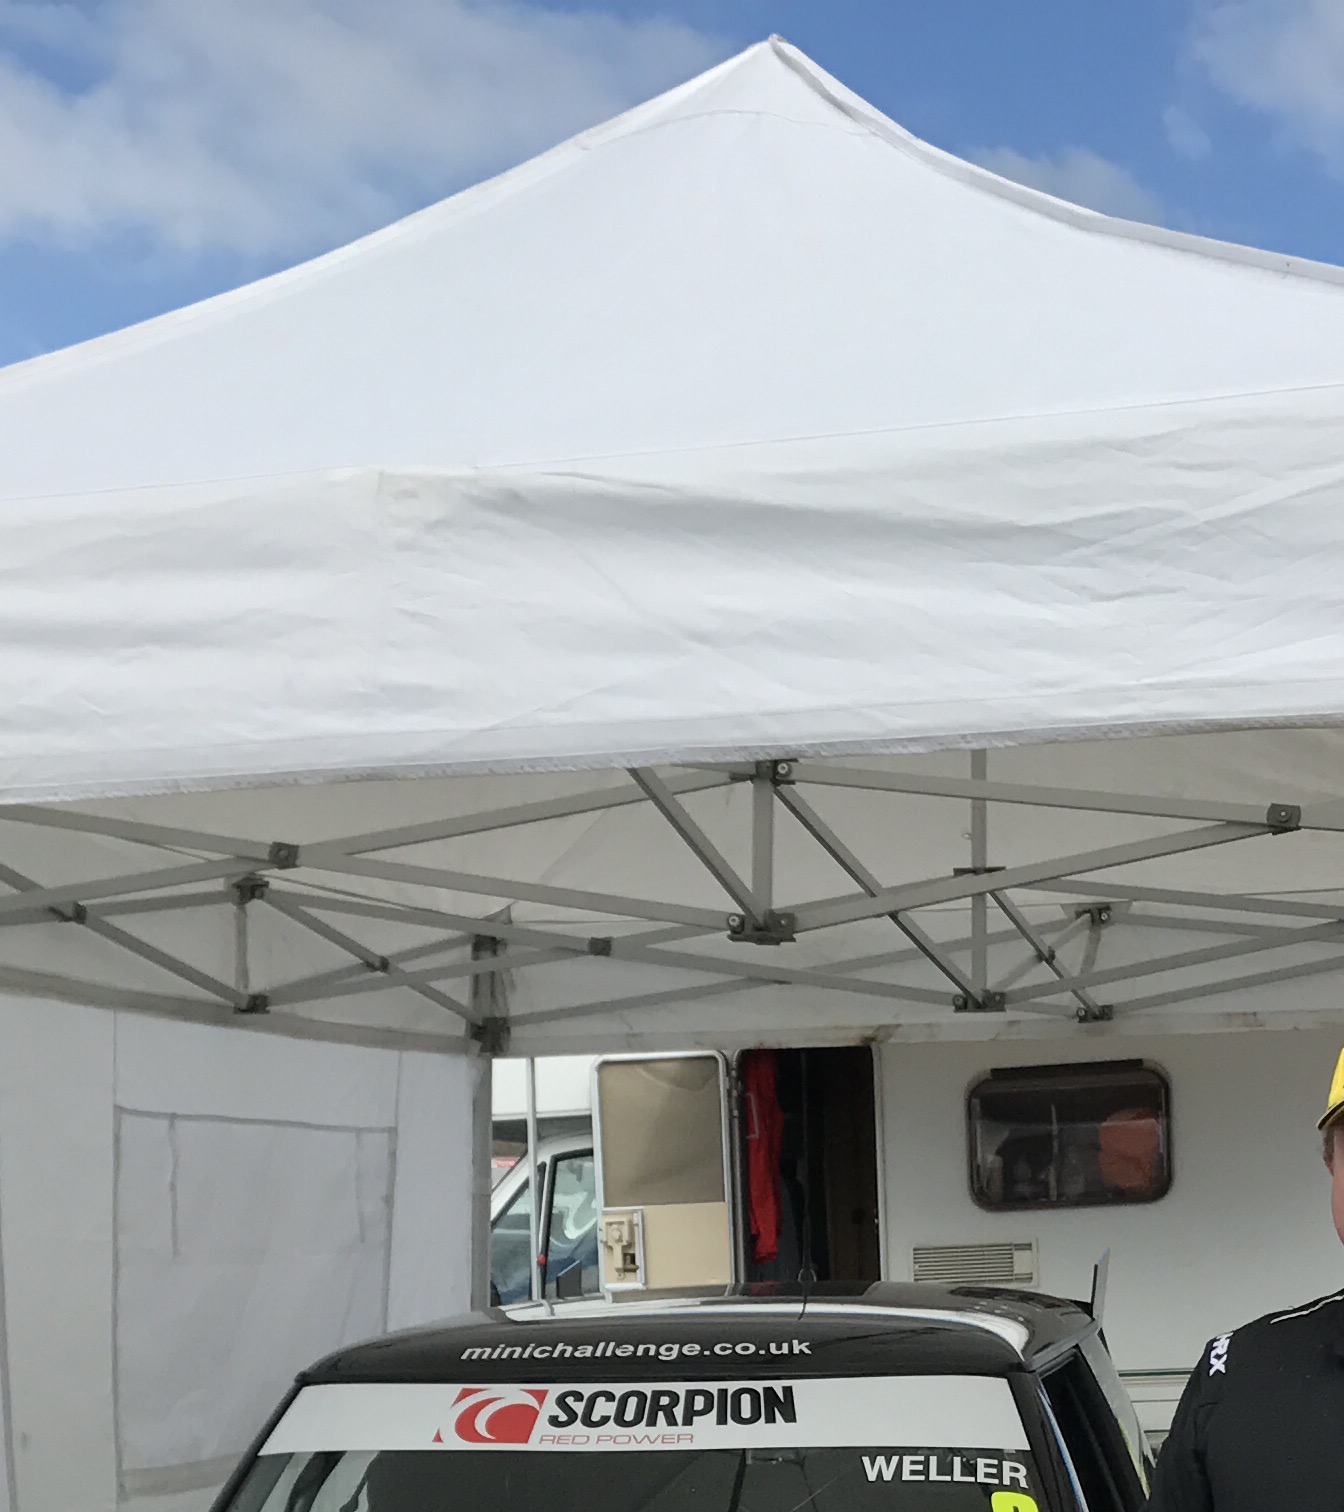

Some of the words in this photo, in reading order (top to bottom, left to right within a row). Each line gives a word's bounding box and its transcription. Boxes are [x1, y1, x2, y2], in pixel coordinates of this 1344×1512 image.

[460, 1339, 812, 1361] minichallenge.co.uk
[1208, 1331, 1235, 1377] HRX
[547, 1385, 798, 1428] SCORPION
[538, 1434, 590, 1445] RED
[596, 1433, 694, 1445] POWER
[861, 1455, 1029, 1489] WELLER
